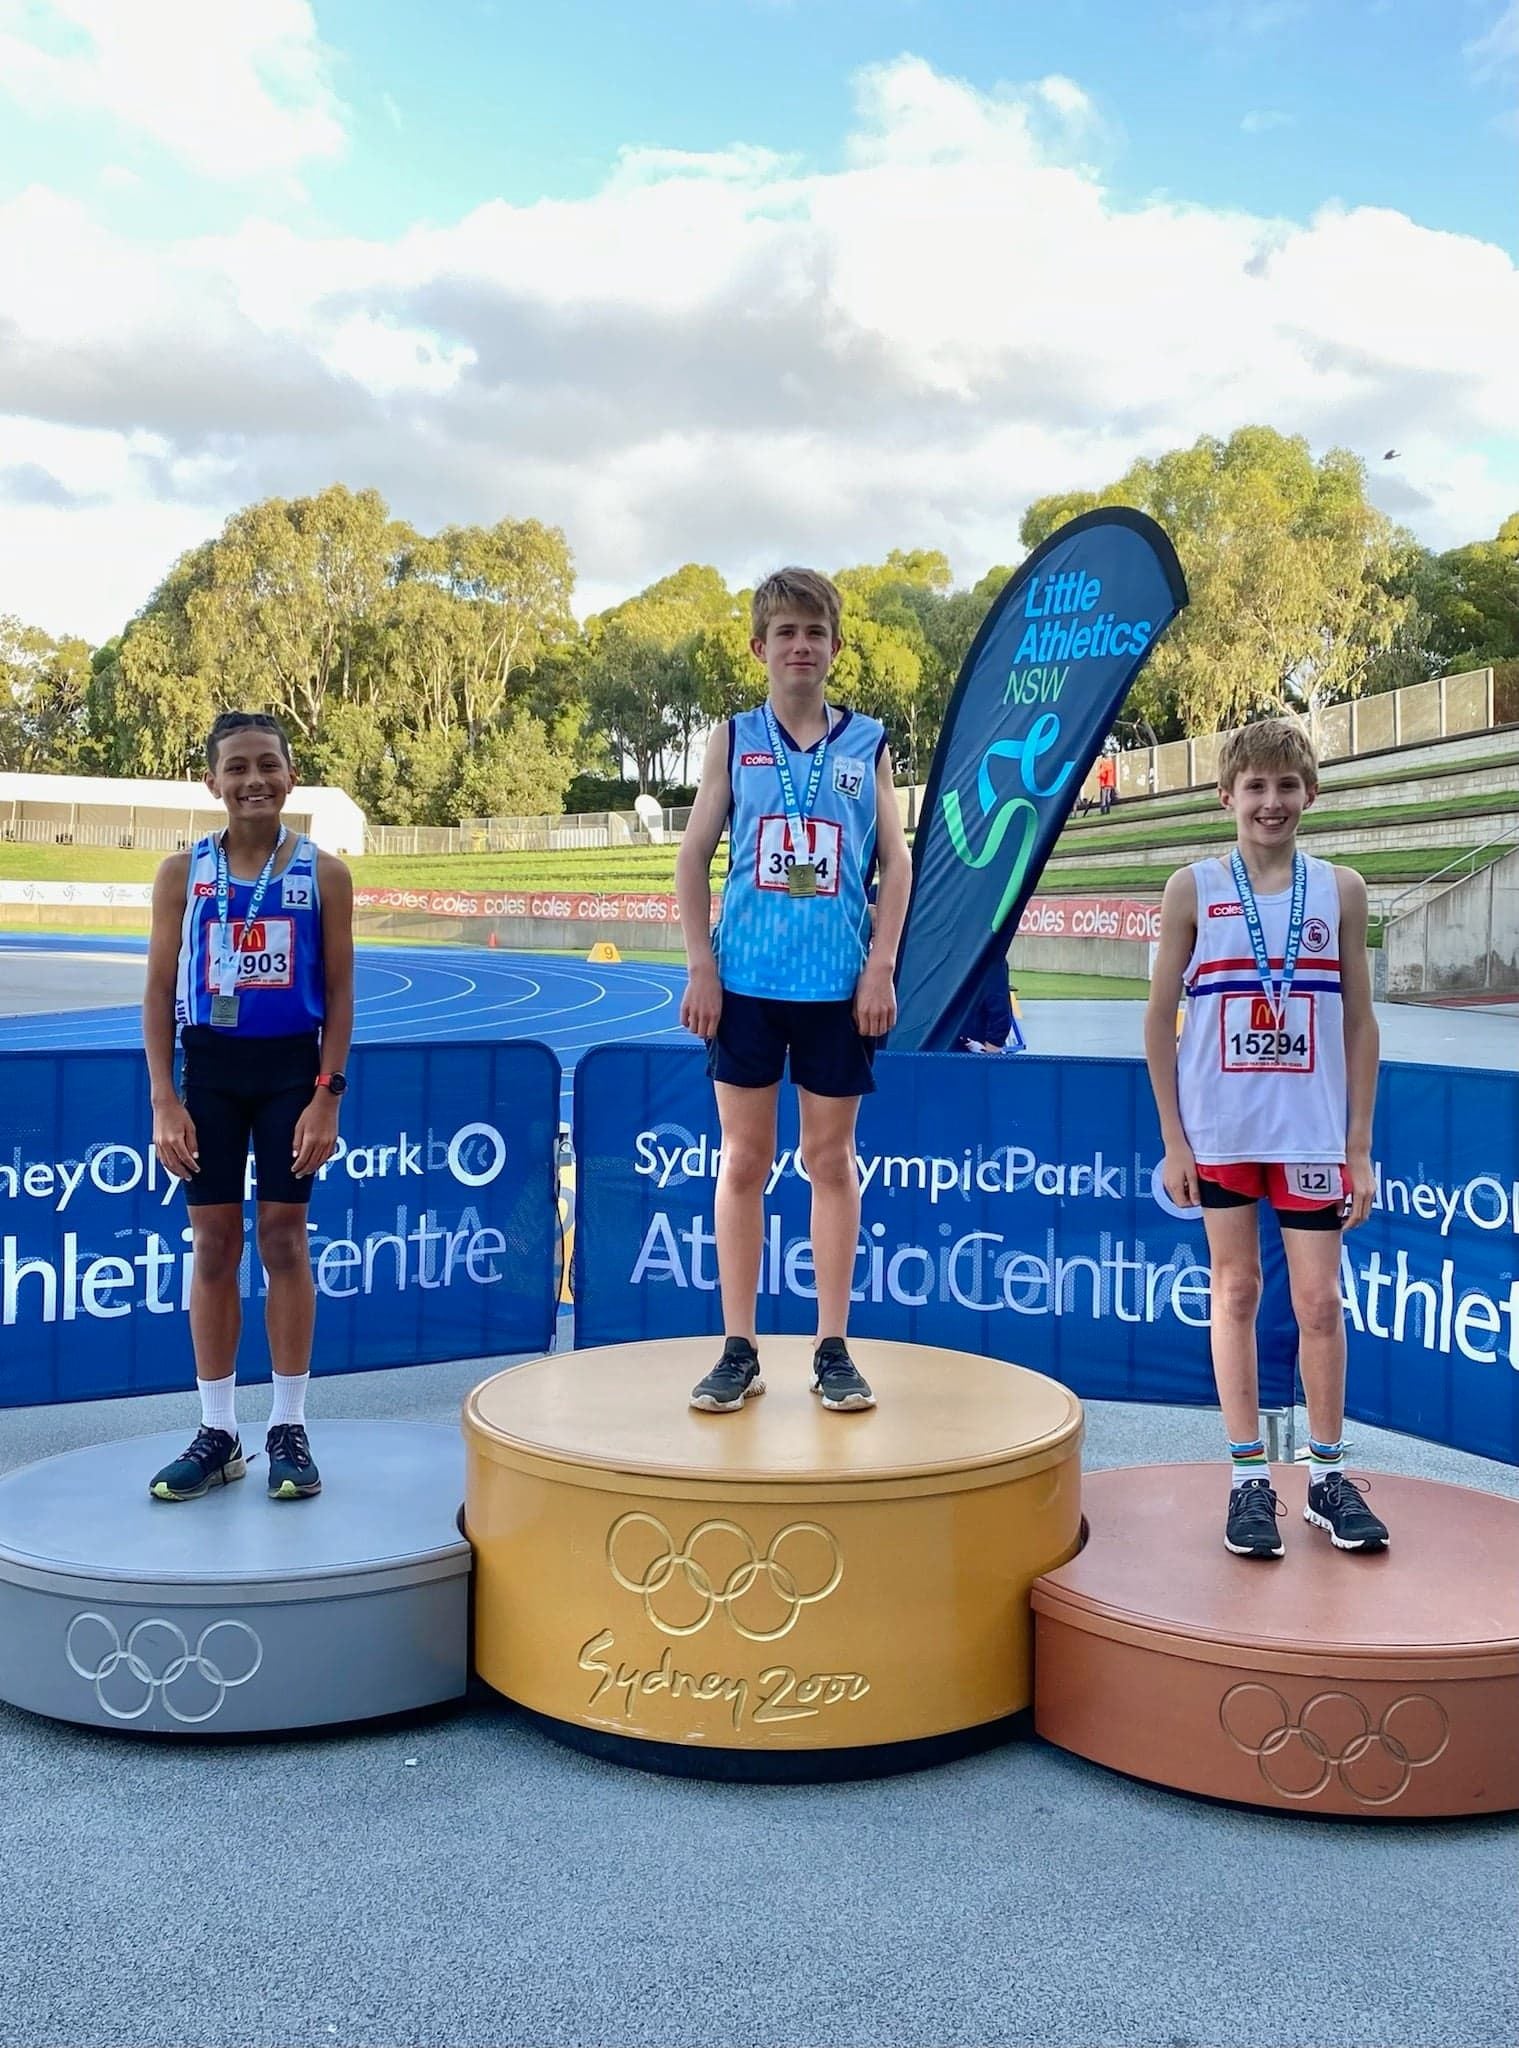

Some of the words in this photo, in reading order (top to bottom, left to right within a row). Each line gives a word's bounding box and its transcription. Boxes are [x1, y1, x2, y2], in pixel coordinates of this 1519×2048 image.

[1024, 570, 1101, 618] Little
[1013, 613, 1151, 665] Athletics
[1003, 666, 1070, 705] NSW
[745, 755, 774, 765] coles
[780, 768, 796, 807] STATE
[805, 770, 821, 807] STATE
[839, 773, 858, 792] 12
[769, 853, 828, 879] 394
[286, 890, 309, 905] 12
[431, 894, 478, 914] coles
[484, 894, 526, 915] coles
[531, 895, 572, 917] coles
[578, 896, 620, 918] coles
[626, 898, 667, 920] coles
[1213, 905, 1244, 916] coles
[1019, 904, 1065, 933] coles
[1071, 904, 1120, 934] coles
[1126, 909, 1161, 938] cole
[603, 946, 614, 960] 9
[1250, 927, 1268, 969] STATE
[1285, 930, 1300, 970] STATE
[1231, 1032, 1308, 1056] 15294
[1301, 1173, 1327, 1189] 12
[578, 1627, 748, 1732] Sydney
[752, 1665, 871, 1723] 2000
